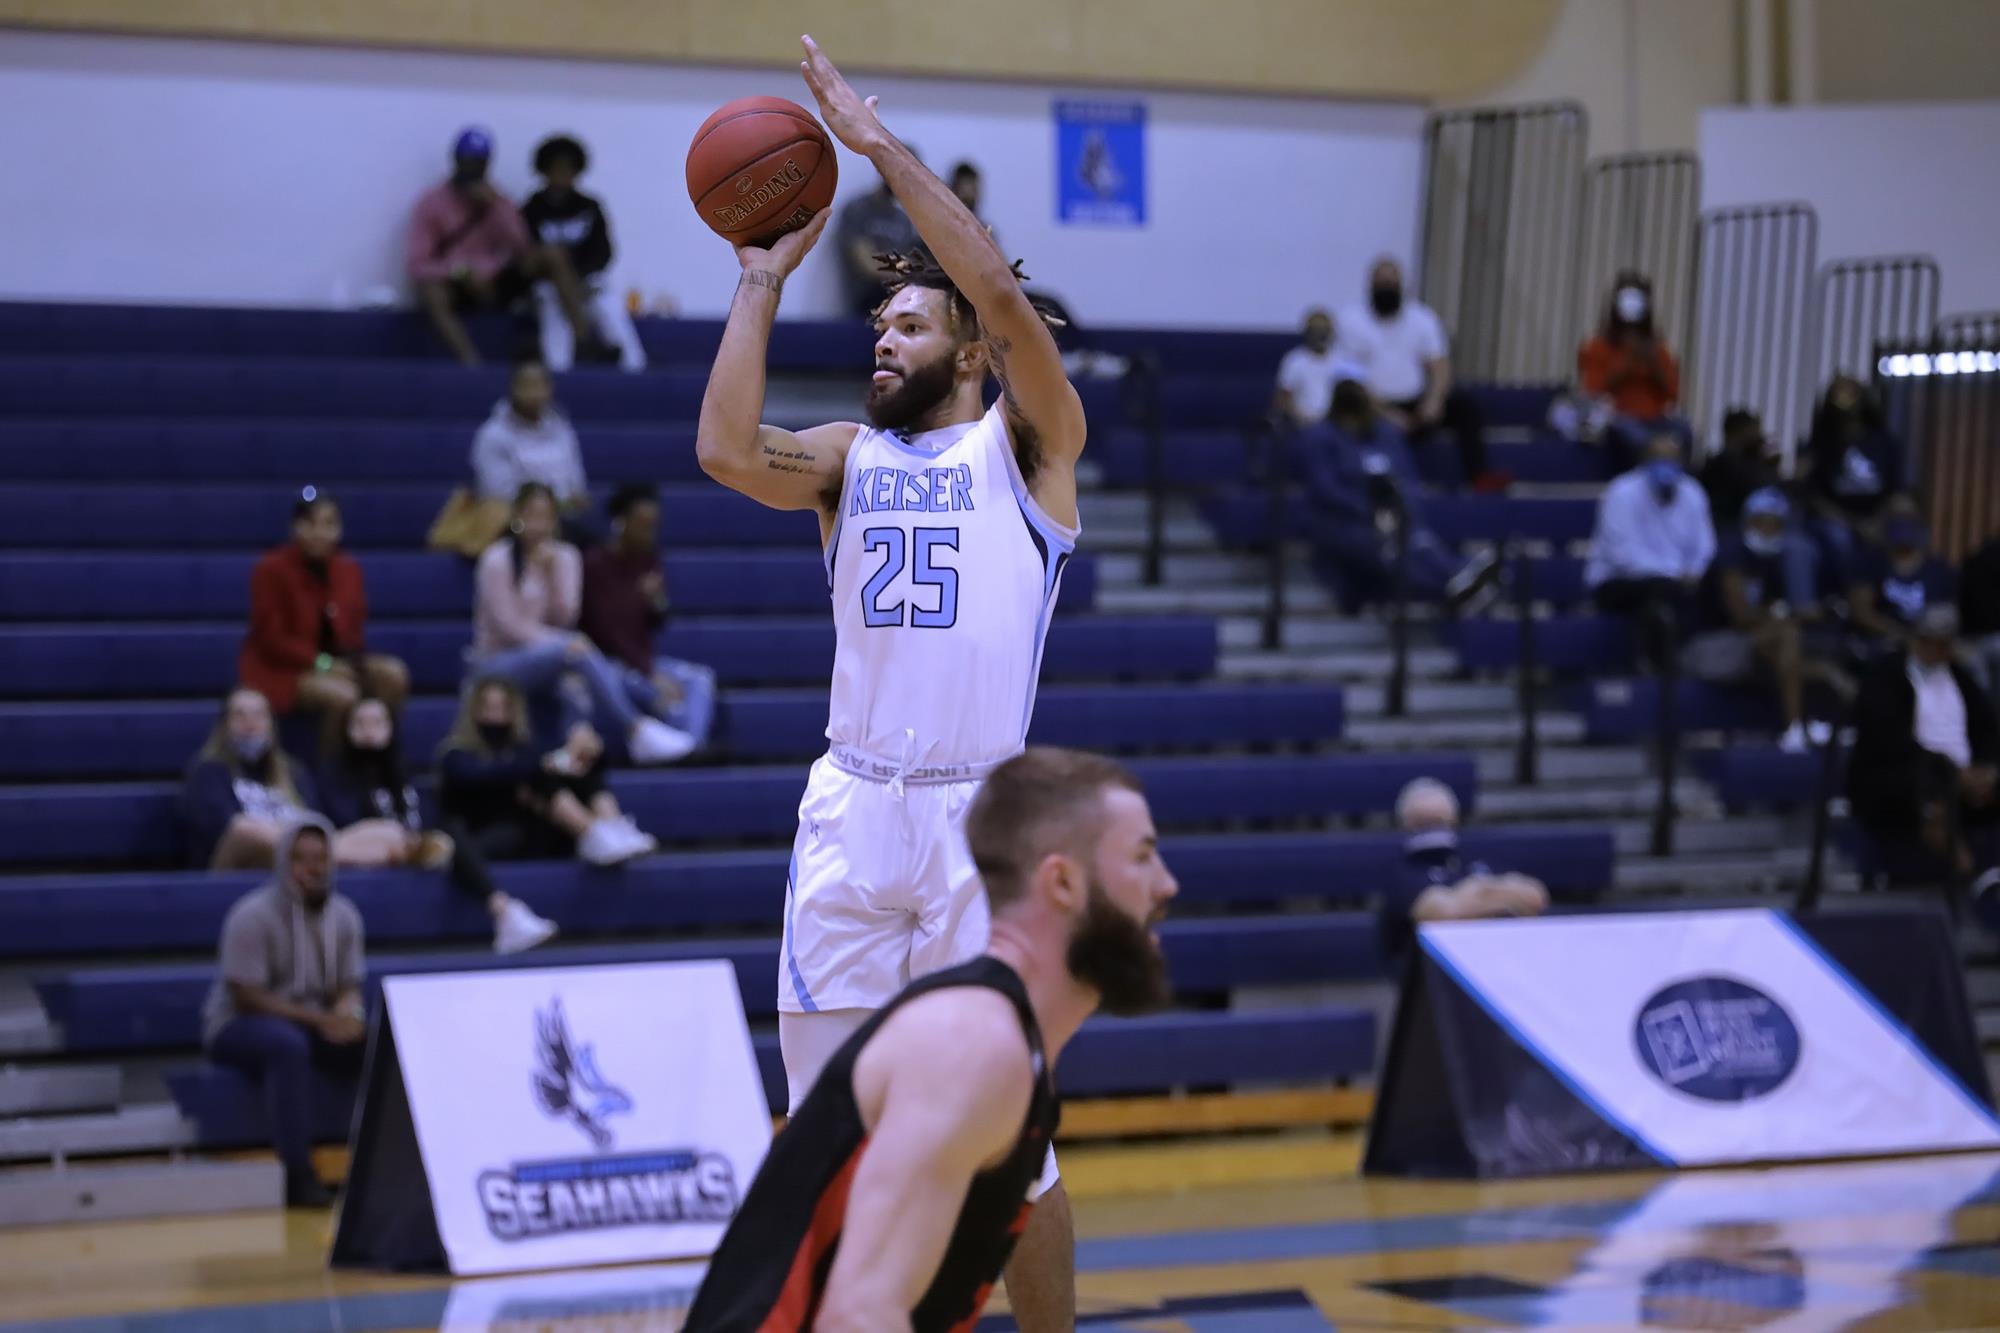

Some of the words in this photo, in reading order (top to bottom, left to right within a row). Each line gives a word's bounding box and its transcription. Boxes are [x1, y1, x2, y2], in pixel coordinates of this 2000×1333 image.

[850, 463, 974, 517] KEISER
[861, 526, 959, 628] 25
[479, 1153, 738, 1241] SEAHAWKS
